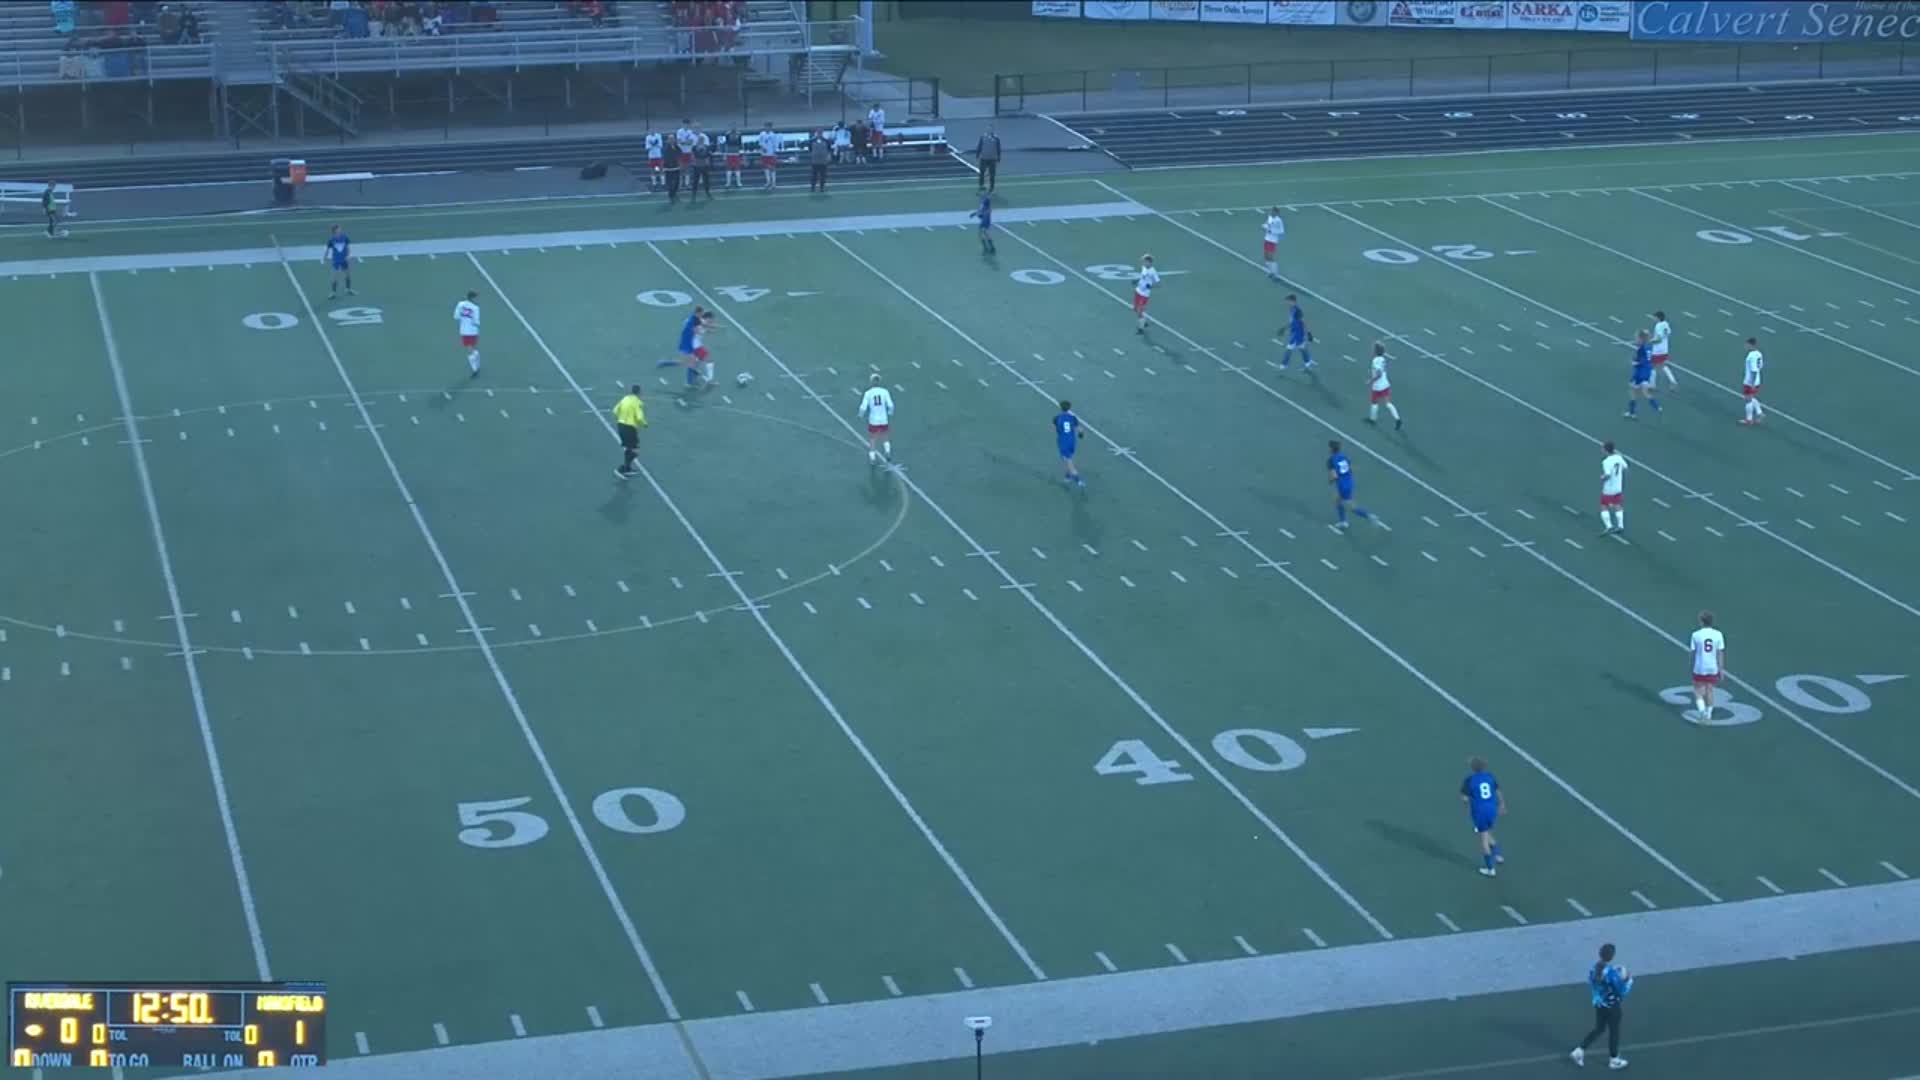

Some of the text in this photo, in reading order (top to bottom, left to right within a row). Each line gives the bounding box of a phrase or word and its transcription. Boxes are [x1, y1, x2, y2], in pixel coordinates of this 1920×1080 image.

[1511, 3, 1573, 17] SARKA
[1637, 2, 1791, 34] Calvert
[1802, 2, 1920, 37] Senec
[872, 394, 882, 406] 11
[1703, 638, 1713, 653] 6
[1093, 727, 1307, 785] 40
[1479, 782, 1492, 800] 8
[456, 786, 686, 848] 50
